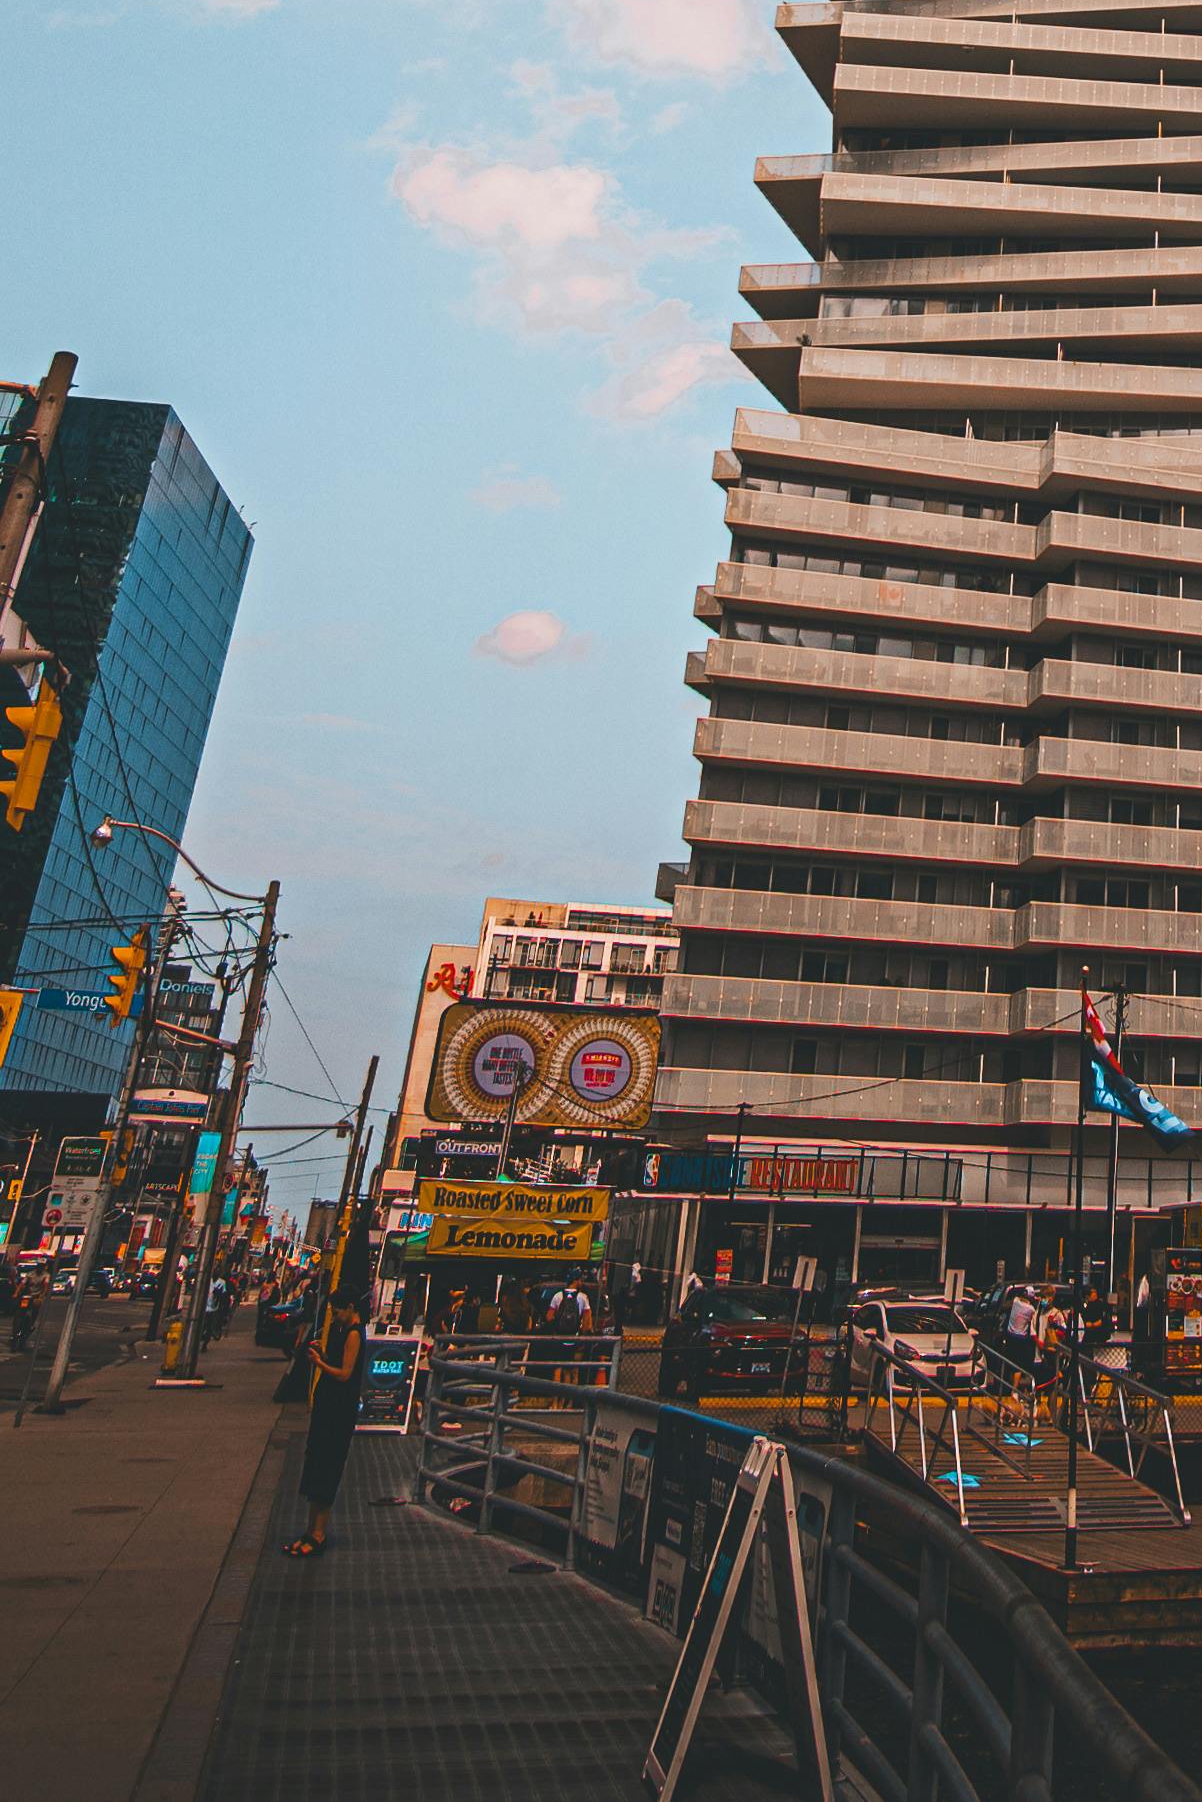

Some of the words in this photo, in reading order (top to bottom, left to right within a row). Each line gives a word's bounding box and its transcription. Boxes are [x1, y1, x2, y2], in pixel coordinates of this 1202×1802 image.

[159, 978, 214, 995] Daniels
[438, 1140, 501, 1154] OUTFRONT
[751, 1156, 859, 1192] RESTAURANT
[433, 1186, 501, 1211] Roasted
[505, 1188, 553, 1214] Sweet
[556, 1191, 594, 1214] Corn
[444, 1224, 578, 1251] Lemonade
[373, 1360, 405, 1369] TDOT
